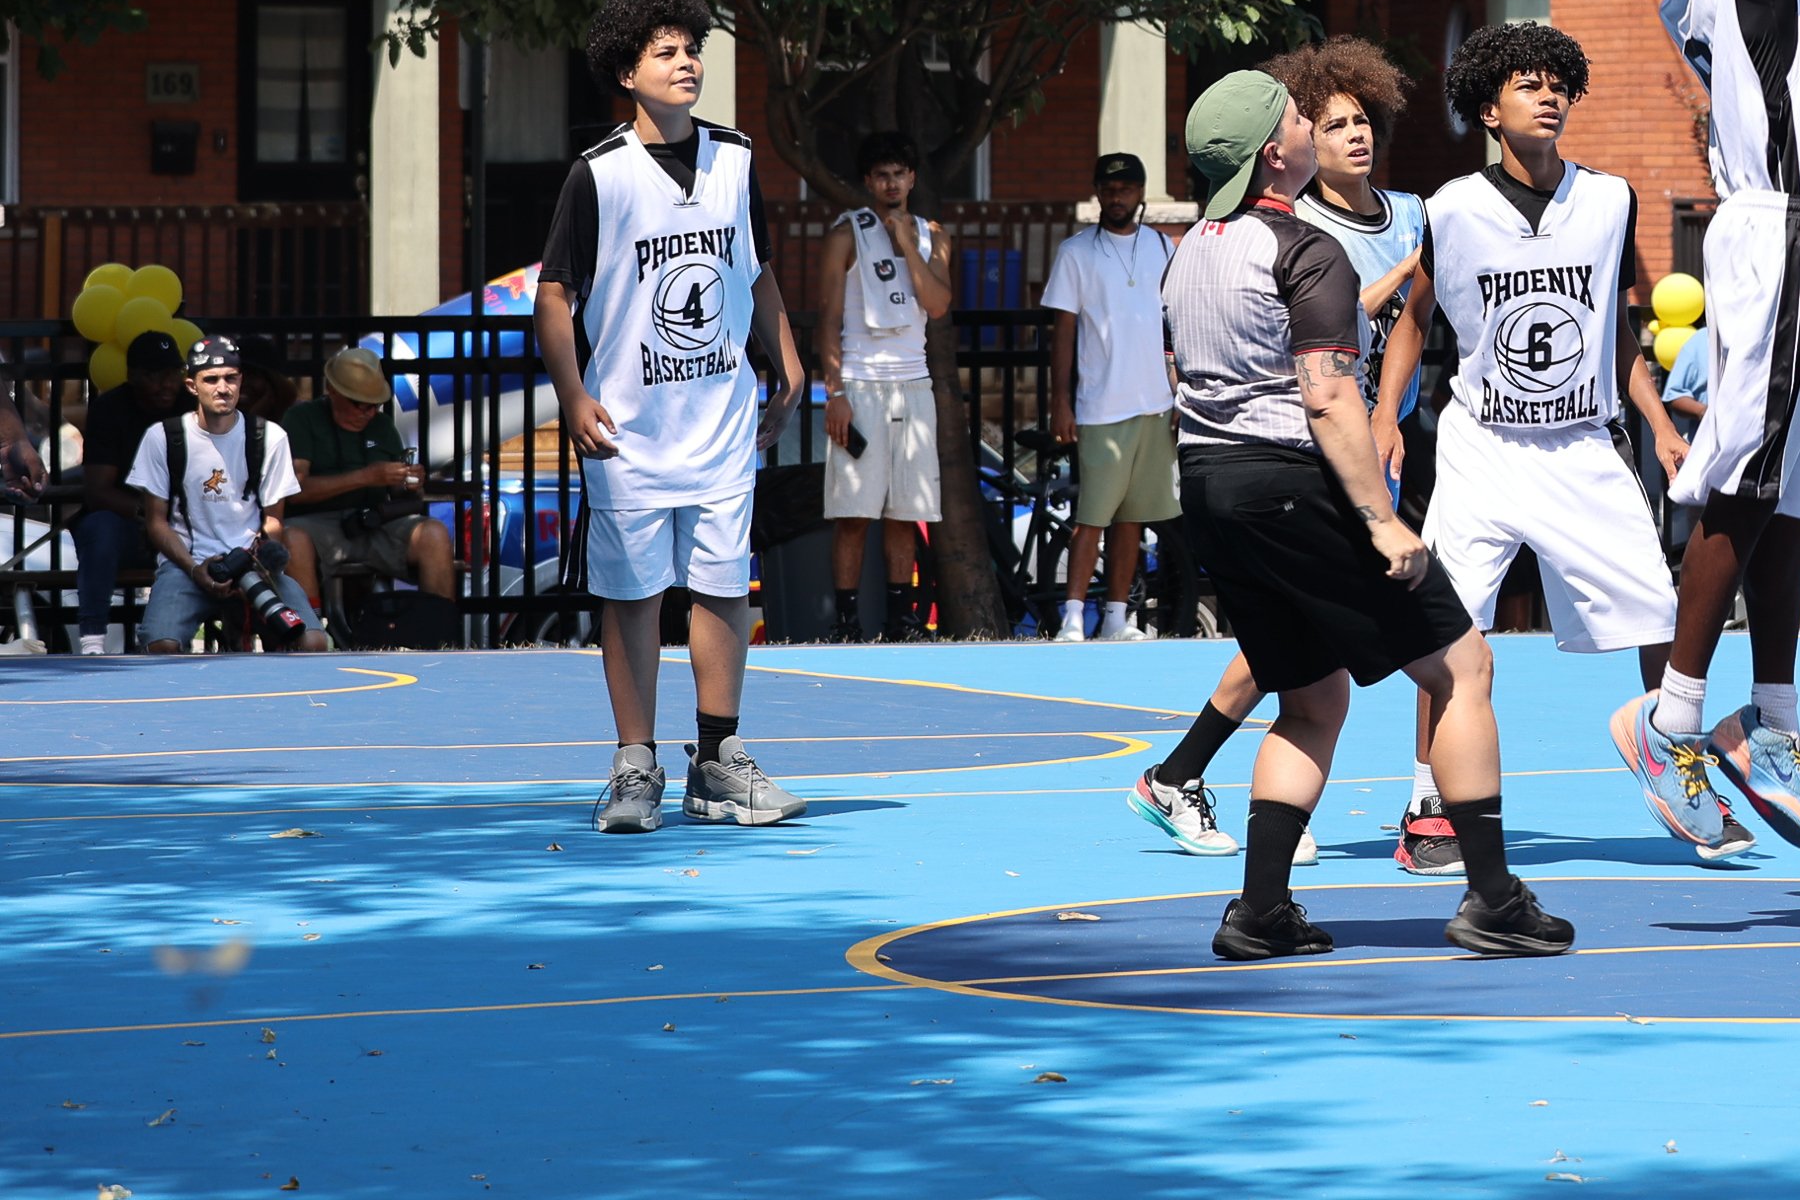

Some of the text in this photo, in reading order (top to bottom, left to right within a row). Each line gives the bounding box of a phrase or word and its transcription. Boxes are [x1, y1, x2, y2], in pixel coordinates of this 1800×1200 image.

[151, 72, 193, 95] 169
[635, 226, 736, 284] PHOENIX
[682, 282, 704, 329] 4
[1476, 265, 1596, 322] PHOENIX
[640, 327, 738, 387] BASKETBALL
[1528, 322, 1553, 372] 6
[1480, 376, 1599, 424] BASKETBALL
